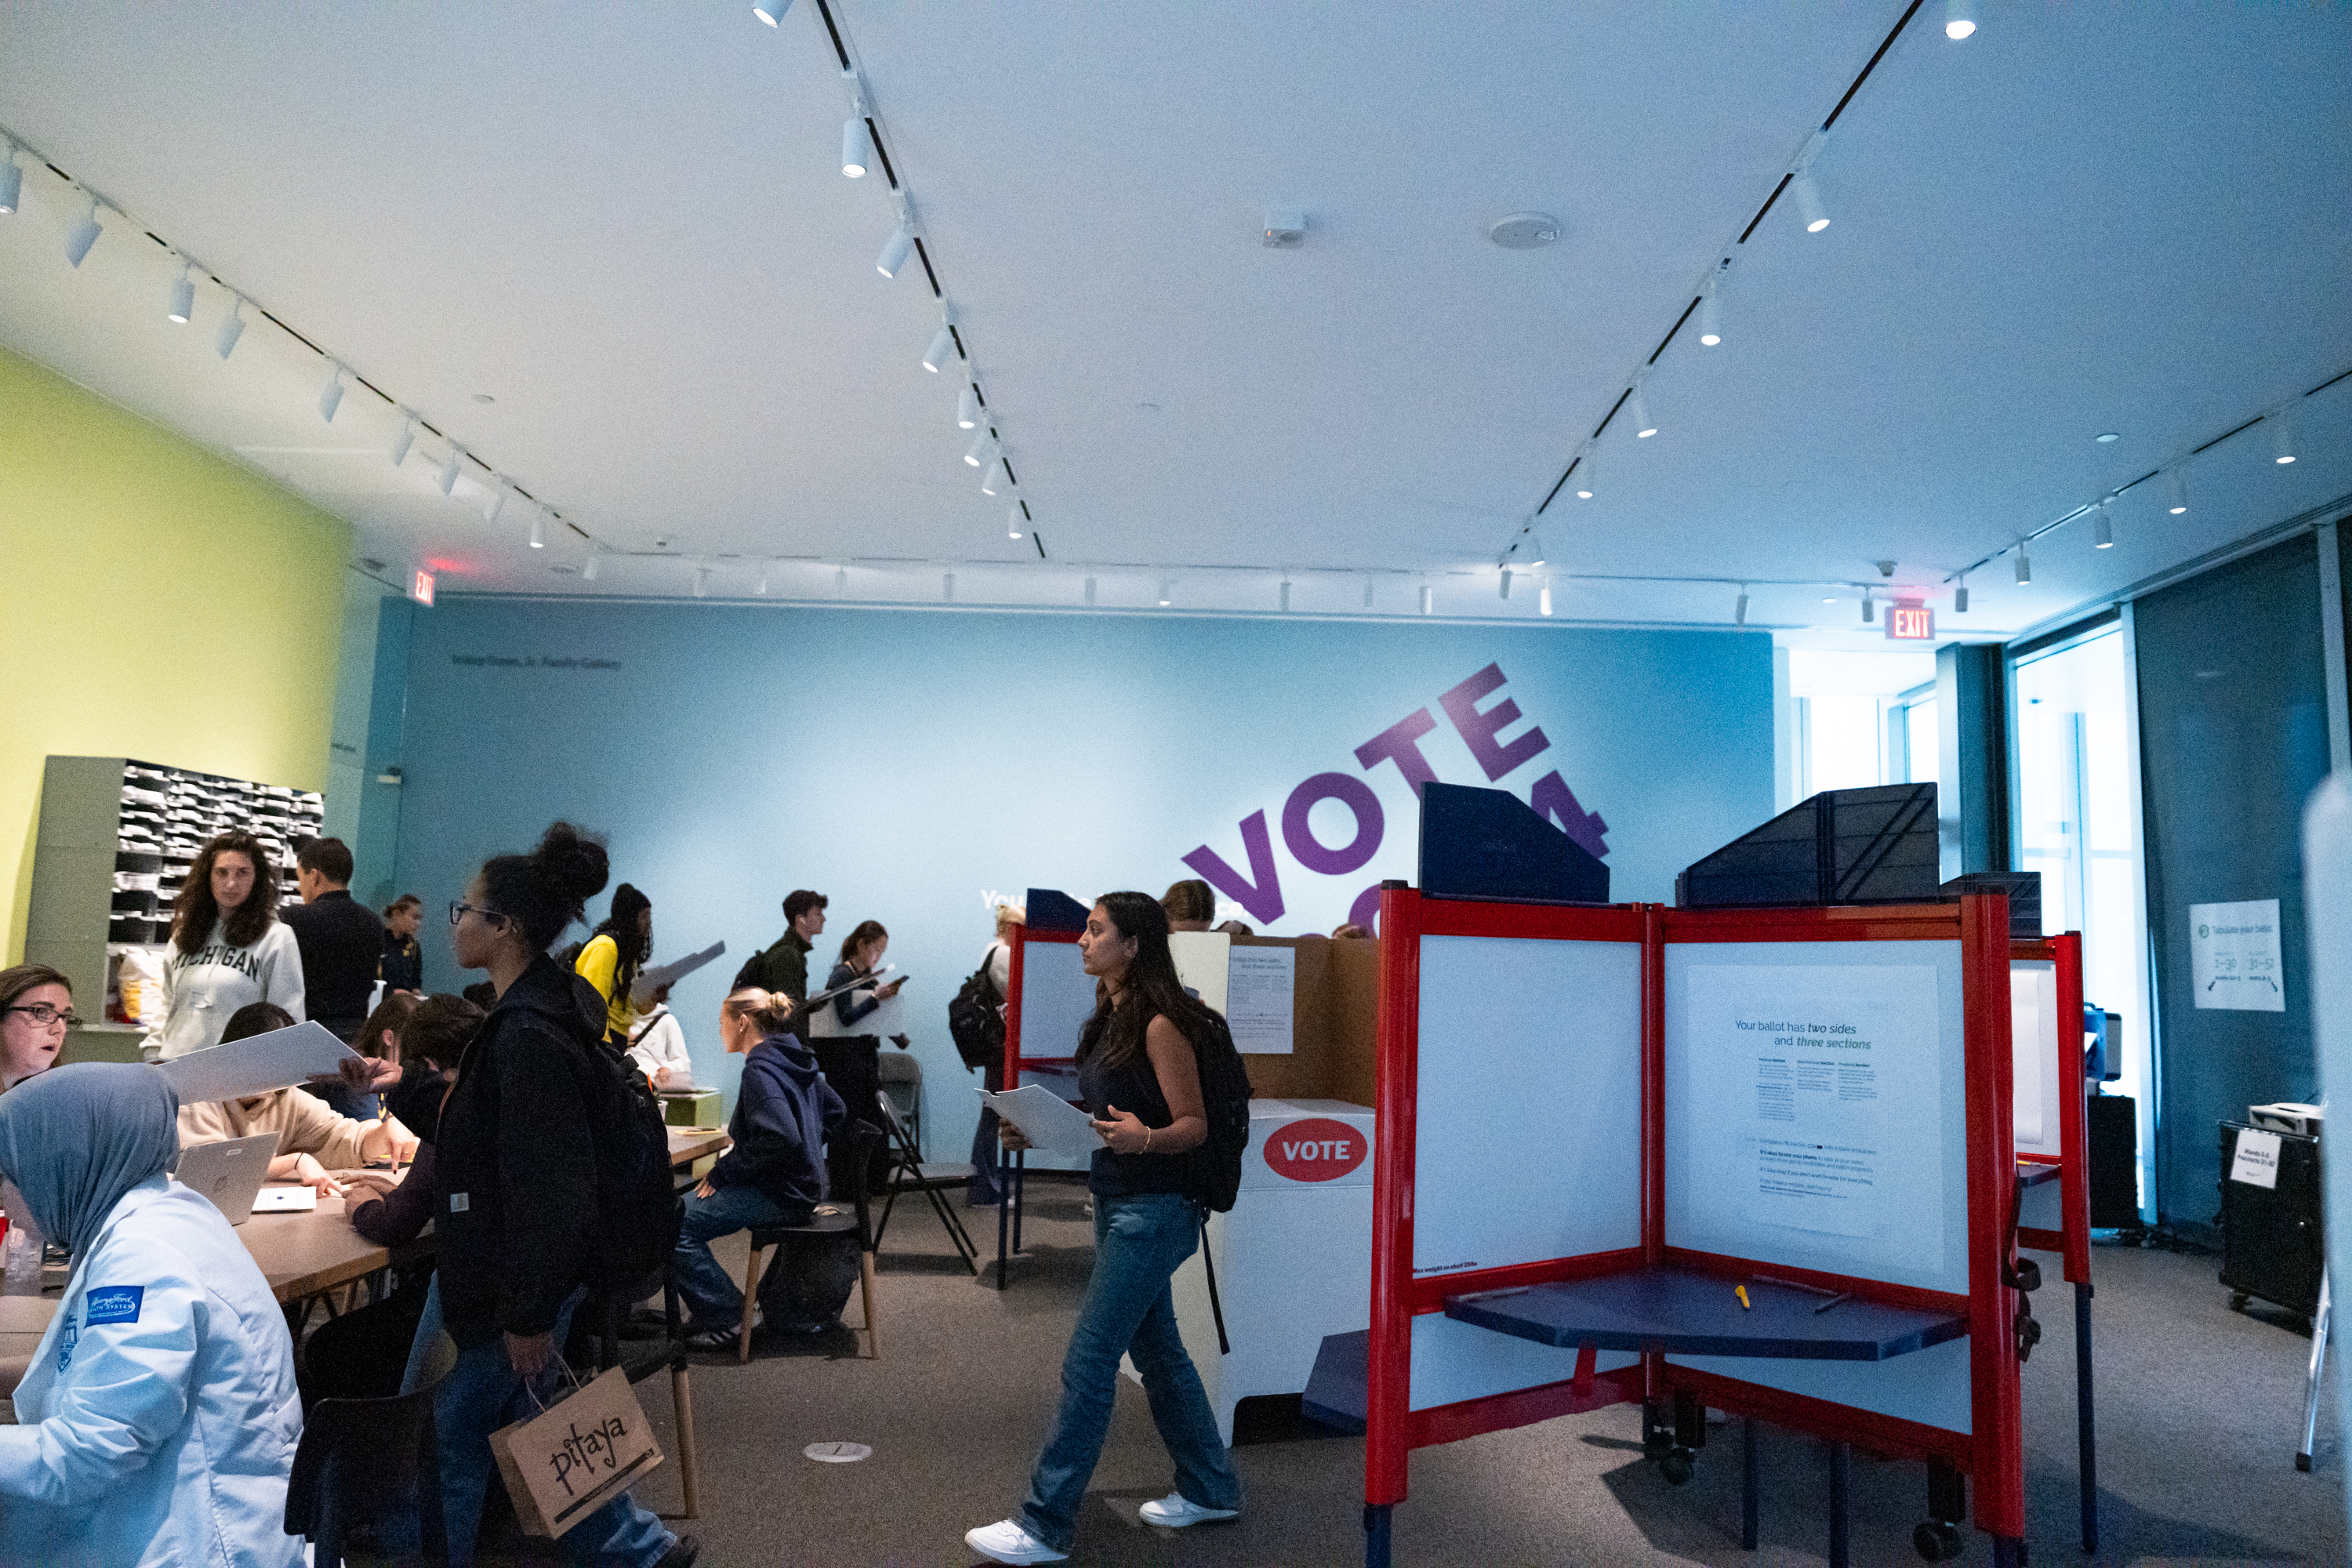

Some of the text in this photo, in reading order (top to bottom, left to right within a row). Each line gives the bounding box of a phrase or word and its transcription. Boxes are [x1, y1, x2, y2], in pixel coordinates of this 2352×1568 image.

[416, 571, 434, 604] EXIT
[1894, 610, 1929, 638] EXIT
[1181, 662, 1551, 925] VOTE
[1735, 1020, 1857, 1035] Your ballot has two sides
[1774, 1036, 1871, 1050] and three sections
[1283, 1141, 1350, 1160] VOTE
[549, 1417, 628, 1496] pitaya
